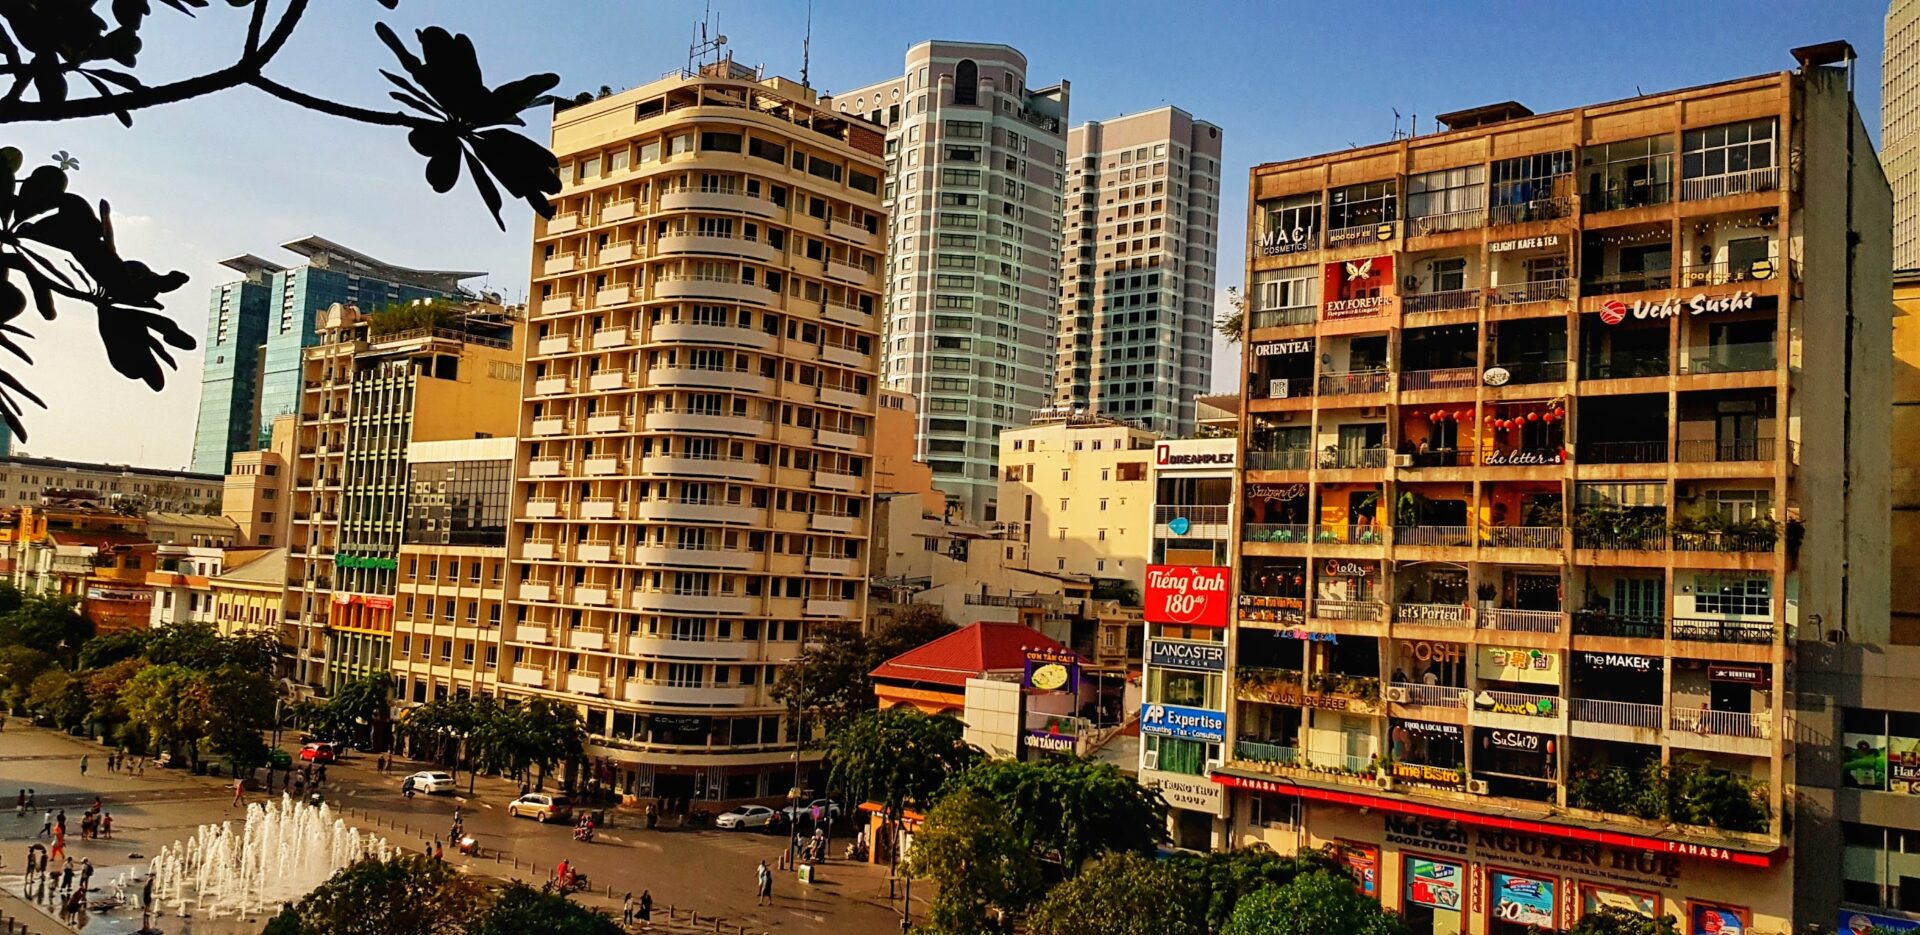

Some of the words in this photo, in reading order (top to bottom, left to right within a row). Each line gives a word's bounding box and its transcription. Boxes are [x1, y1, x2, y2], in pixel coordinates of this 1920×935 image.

[1260, 227, 1312, 246] MACI
[1517, 237, 1536, 250] KAFE
[1537, 237, 1543, 247] &
[1544, 235, 1558, 247] TEA
[1263, 243, 1307, 255] COSMETICS
[1347, 296, 1389, 310] FOREVER
[1634, 299, 1681, 319] Uchi
[1690, 291, 1753, 315] Sushi
[1256, 341, 1309, 356] ORIENTEA
[1169, 454, 1234, 465] DREAMPLEX
[1485, 450, 1506, 464] the
[1508, 449, 1546, 464] letter
[1148, 568, 1188, 594] Tiếng
[1165, 594, 1195, 614] 180
[1154, 642, 1223, 661] LANCASTER
[1584, 652, 1604, 665] the
[1605, 654, 1650, 669] MAKER
[1167, 657, 1208, 667] LINCOLN
[1267, 691, 1301, 704] YOUN
[1304, 696, 1345, 709] COFFEE
[1167, 710, 1222, 729] Expertise
[1142, 723, 1172, 736] Accounting
[1177, 727, 1187, 736] Tax
[1192, 729, 1222, 741] Consulting
[1236, 777, 1276, 791] FAHASA
[1385, 834, 1468, 854] BOOKSTORE
[1669, 841, 1729, 860] FAHASA
